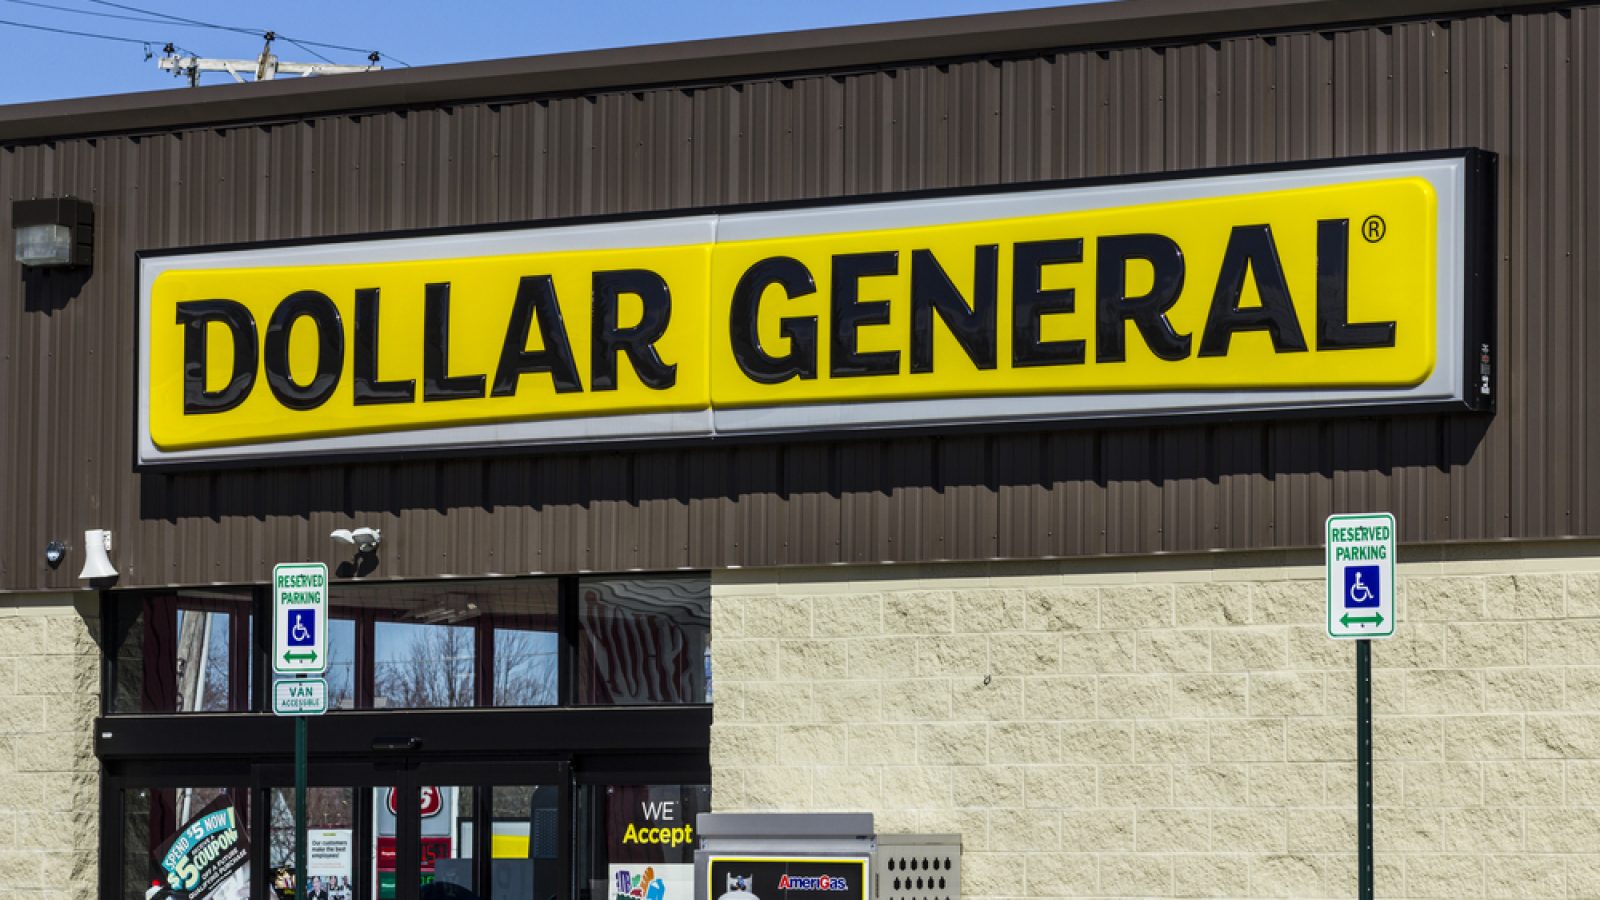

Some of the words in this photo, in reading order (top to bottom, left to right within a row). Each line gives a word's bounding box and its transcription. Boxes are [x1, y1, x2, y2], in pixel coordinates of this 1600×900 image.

[176, 268, 678, 415] DOLLAR
[729, 218, 1397, 384] GENERAL
[1332, 525, 1390, 542] RESERVED
[1335, 545, 1387, 561] PARKING
[278, 574, 324, 588] RESERVED
[281, 591, 321, 605] PARKING
[289, 686, 313, 698] VAN
[281, 698, 320, 707] ACCESSIBLE
[641, 801, 675, 821] WE
[621, 822, 694, 848] Accept
[165, 837, 190, 870] SPEND
[186, 821, 205, 841] $5
[167, 854, 200, 890] $5
